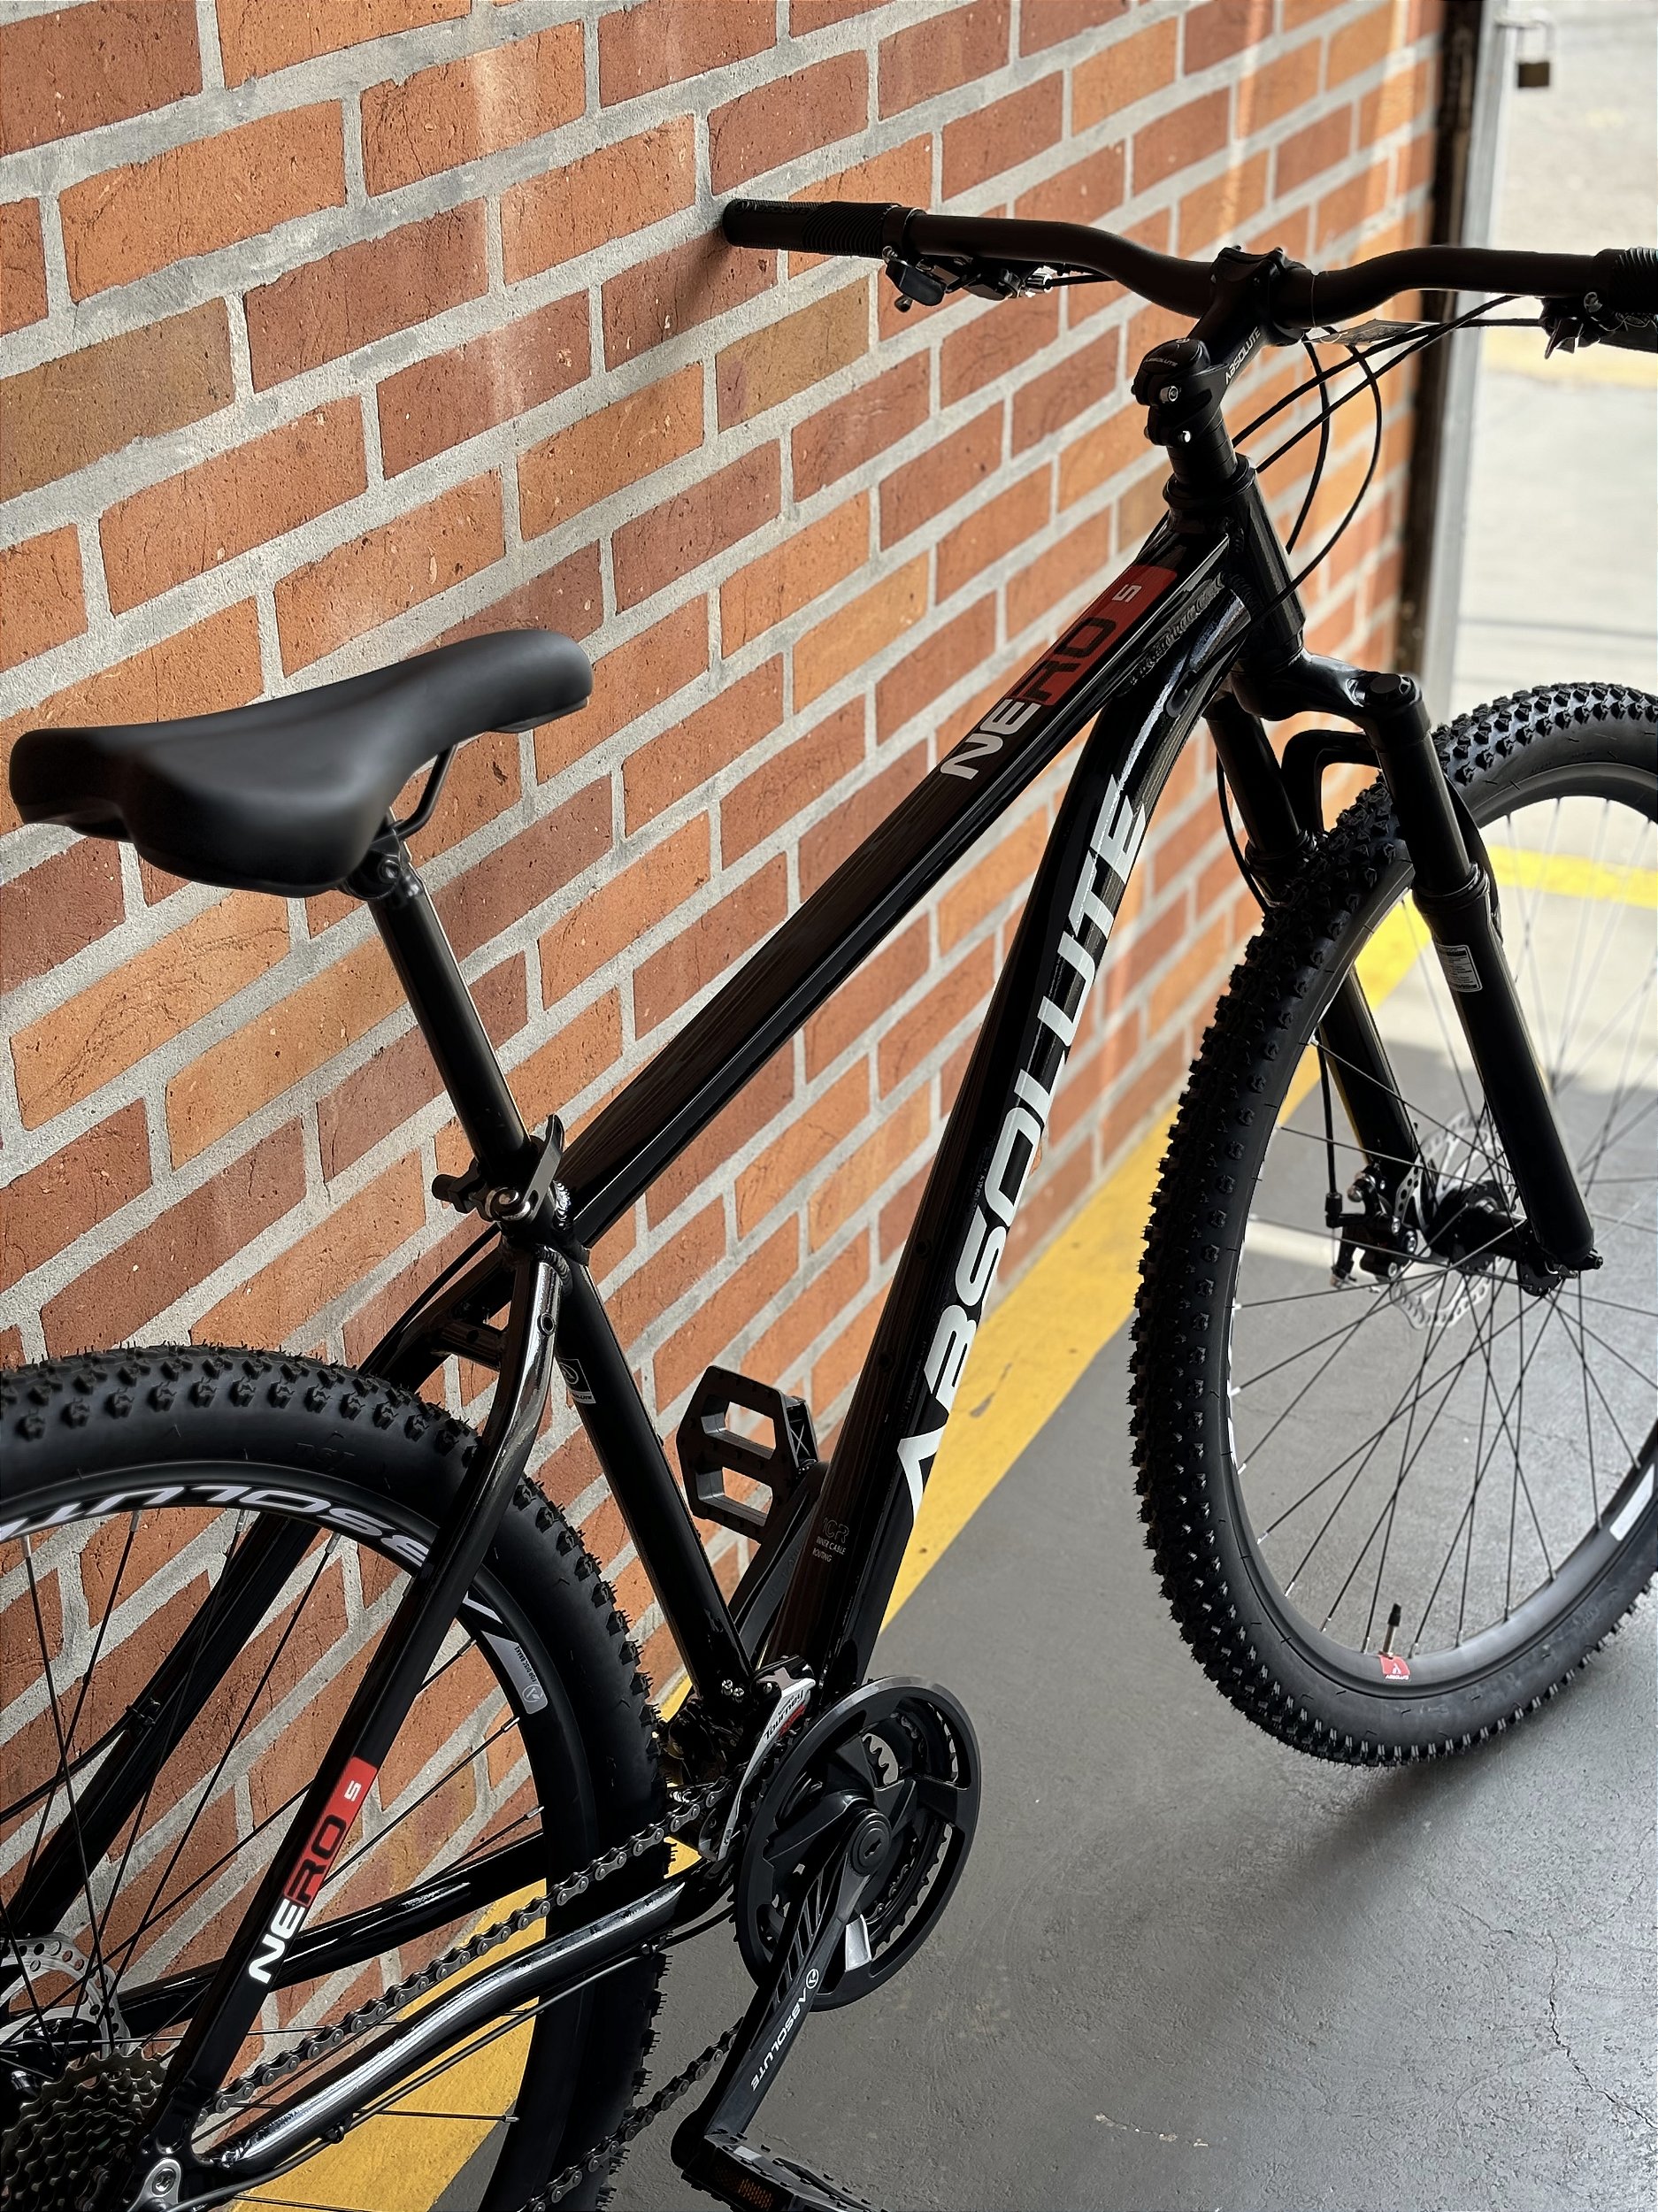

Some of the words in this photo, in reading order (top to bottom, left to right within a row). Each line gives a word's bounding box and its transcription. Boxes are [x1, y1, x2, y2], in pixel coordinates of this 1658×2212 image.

[1224, 326, 1262, 386] ABSOLUTE
[940, 617, 1117, 780] NERO
[897, 773, 1148, 1524] ABSOLUTE
[763, 1688, 804, 1740] Tourney
[248, 1813, 348, 1985] NERO
[750, 1986, 807, 2093] ABSOLUTE
